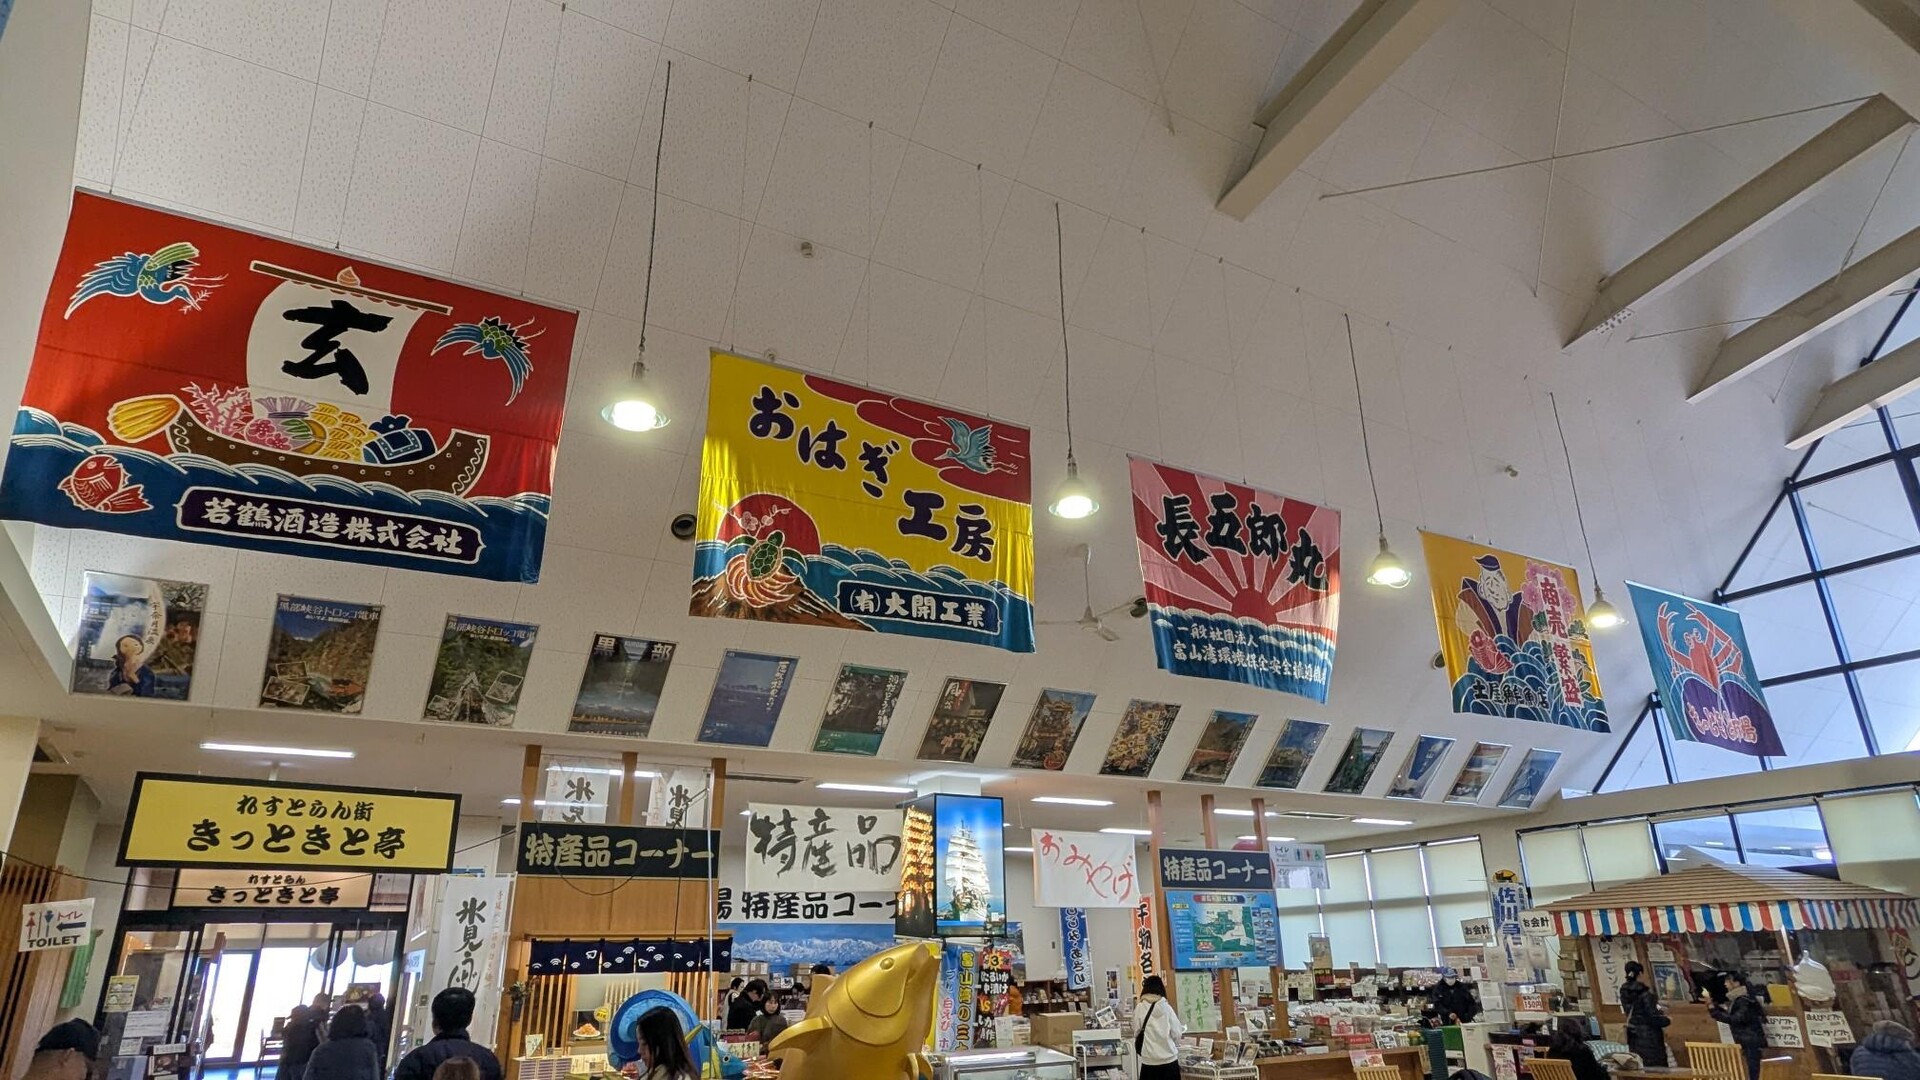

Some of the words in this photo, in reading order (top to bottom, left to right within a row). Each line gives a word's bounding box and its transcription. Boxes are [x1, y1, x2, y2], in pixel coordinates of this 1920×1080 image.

[282, 300, 394, 396] 玄
[748, 385, 995, 563] おはぎ工房
[202, 498, 464, 555] 若鶴酒造株式会社
[1155, 491, 1330, 592] 長五郎丸
[236, 795, 375, 822] れすとらん街
[187, 819, 406, 860] きっときと亭
[525, 833, 715, 869] 特産品コーナー
[749, 808, 902, 879] 特産品
[1039, 831, 1136, 902] おみやげ
[1164, 855, 1270, 881] 特産品コーナー
[206, 885, 341, 905] きっときと亭
[57, 911, 83, 922] トイレ
[1464, 924, 1490, 936] お会計
[1522, 916, 1549, 928] お会計
[27, 935, 81, 949] TOILET
